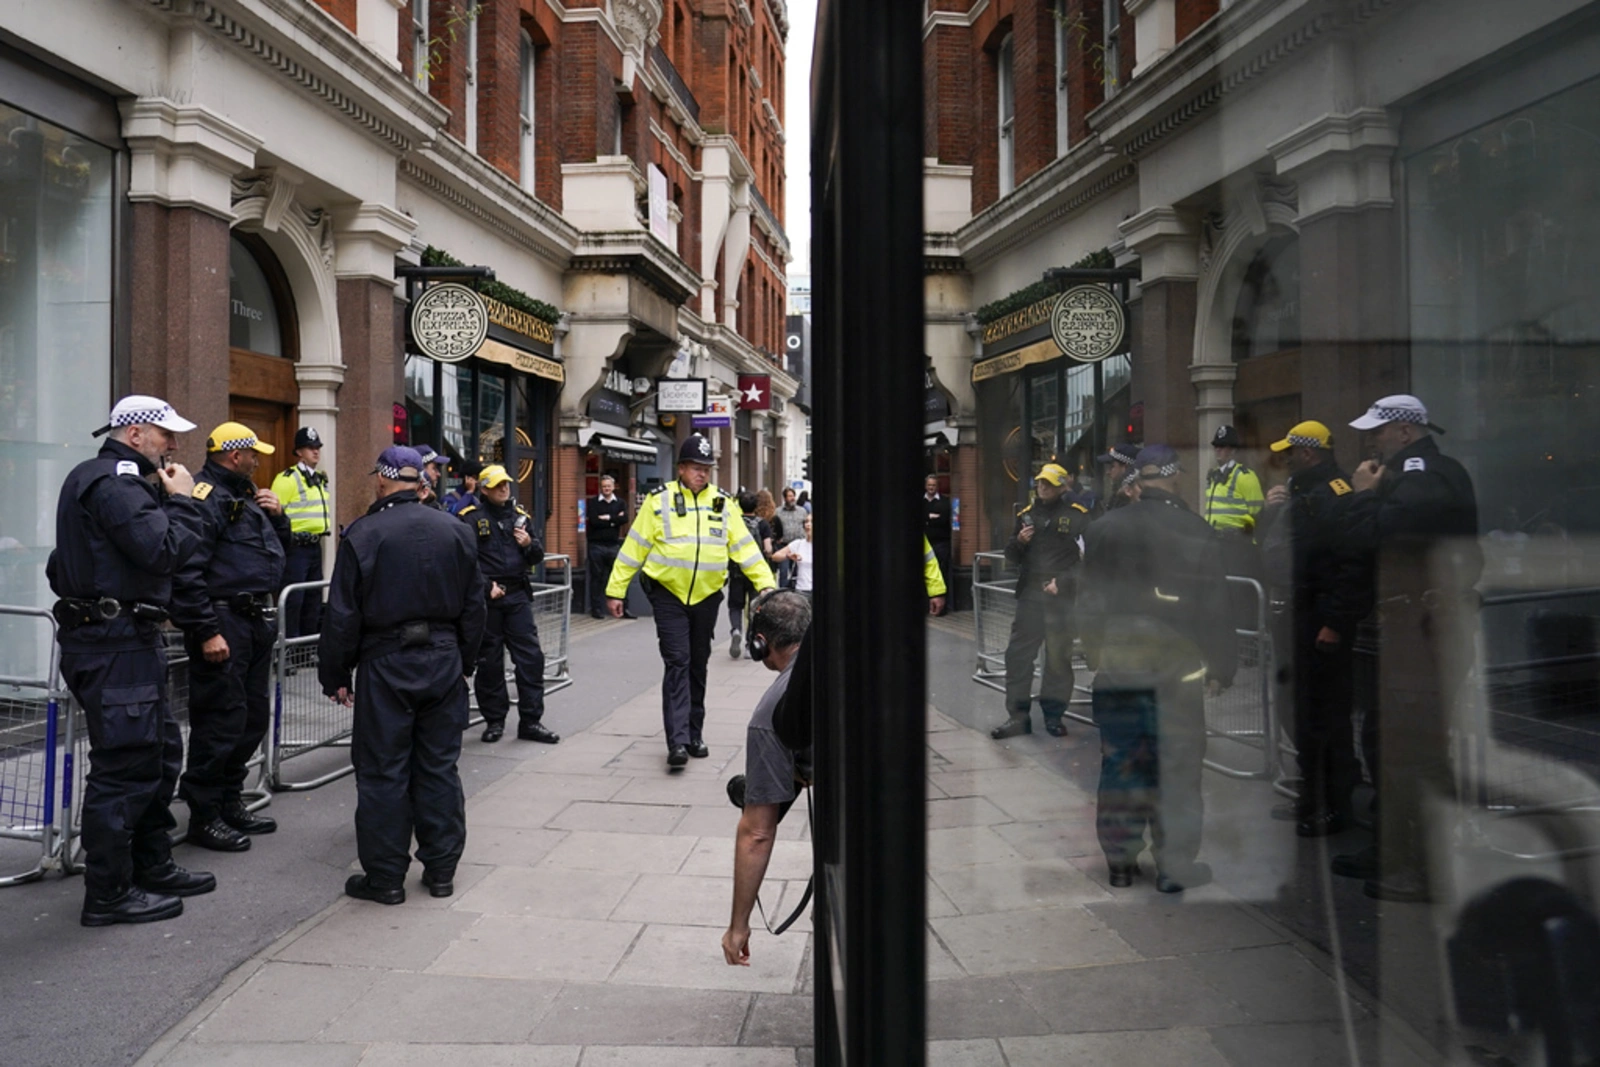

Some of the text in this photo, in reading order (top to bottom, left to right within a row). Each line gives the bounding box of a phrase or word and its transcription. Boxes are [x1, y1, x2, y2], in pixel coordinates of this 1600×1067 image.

[231, 299, 263, 320] Three
[432, 312, 466, 321] PIZZA
[422, 321, 477, 330] EXPRESS
[662, 391, 698, 399] Licence
[707, 402, 727, 412] dEx
